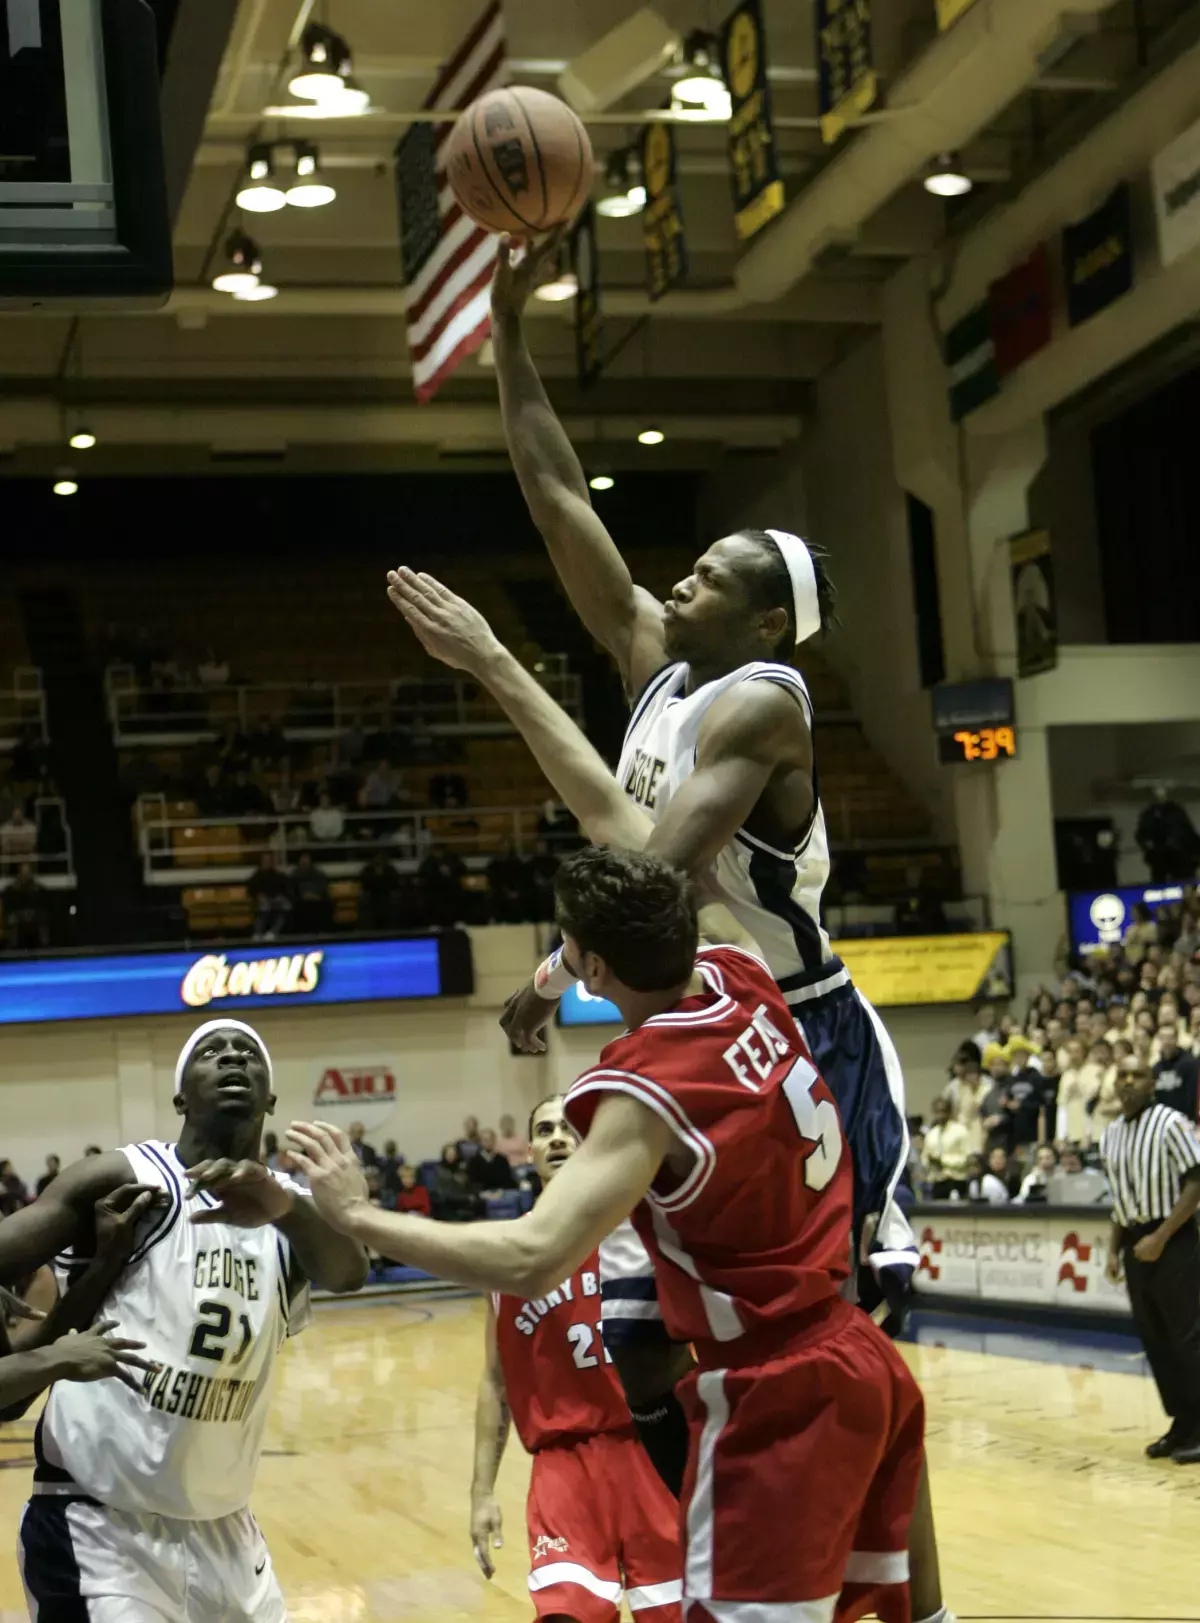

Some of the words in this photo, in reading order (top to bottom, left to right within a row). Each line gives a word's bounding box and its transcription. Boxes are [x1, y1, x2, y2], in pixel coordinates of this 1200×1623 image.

[953, 726, 1015, 760] 7:39
[781, 1056, 842, 1192] 5
[194, 1247, 259, 1301] GEOGE
[514, 1277, 574, 1335] STONY
[142, 1360, 256, 1422] WASHINGTO
